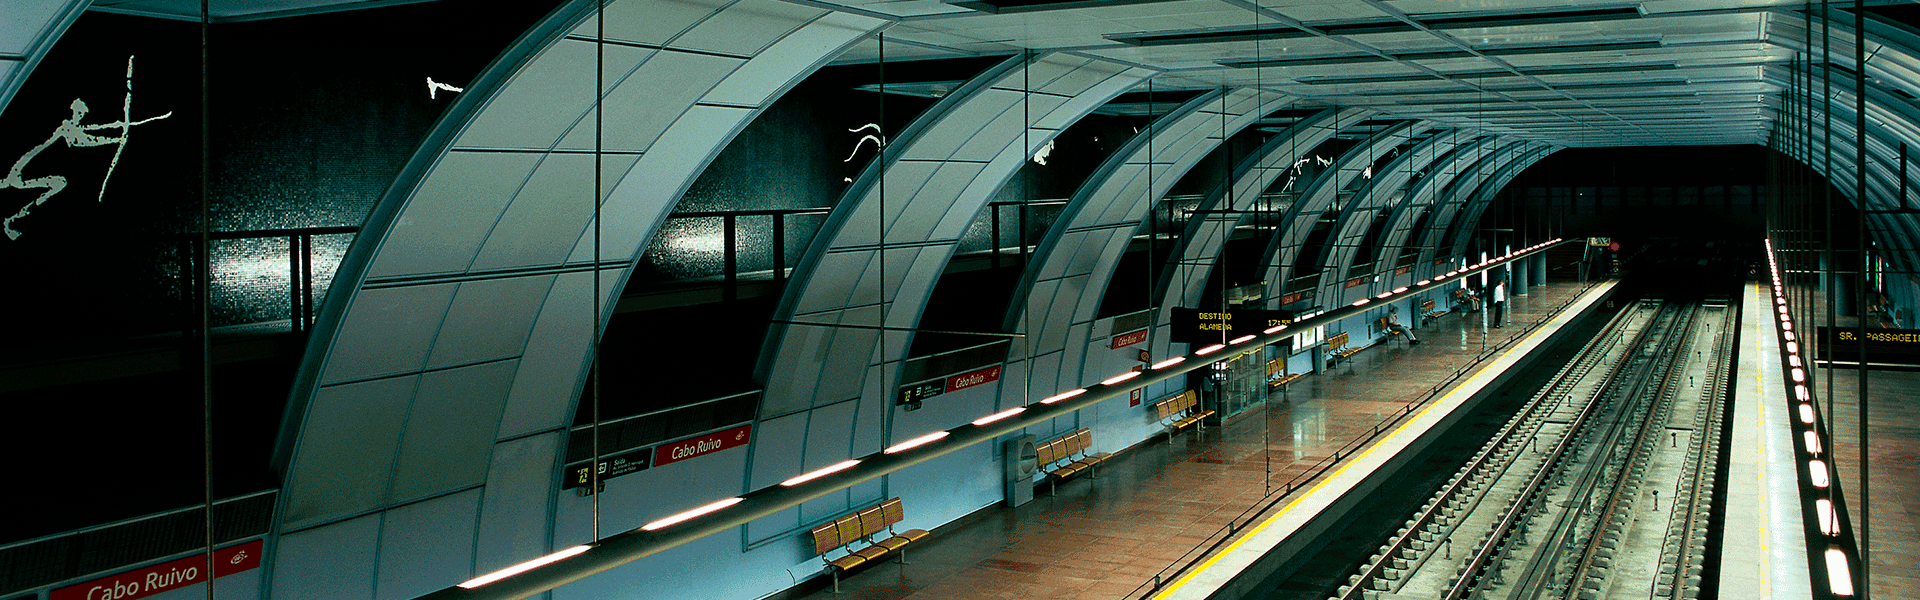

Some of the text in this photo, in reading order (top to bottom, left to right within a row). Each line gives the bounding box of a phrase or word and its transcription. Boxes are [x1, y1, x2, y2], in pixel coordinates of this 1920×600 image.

[1839, 331, 1858, 341] SR.
[955, 373, 984, 389] Cabo Ruivo
[671, 437, 722, 460] Cabo Ruivo
[87, 566, 198, 600] Cabo Ruivo
